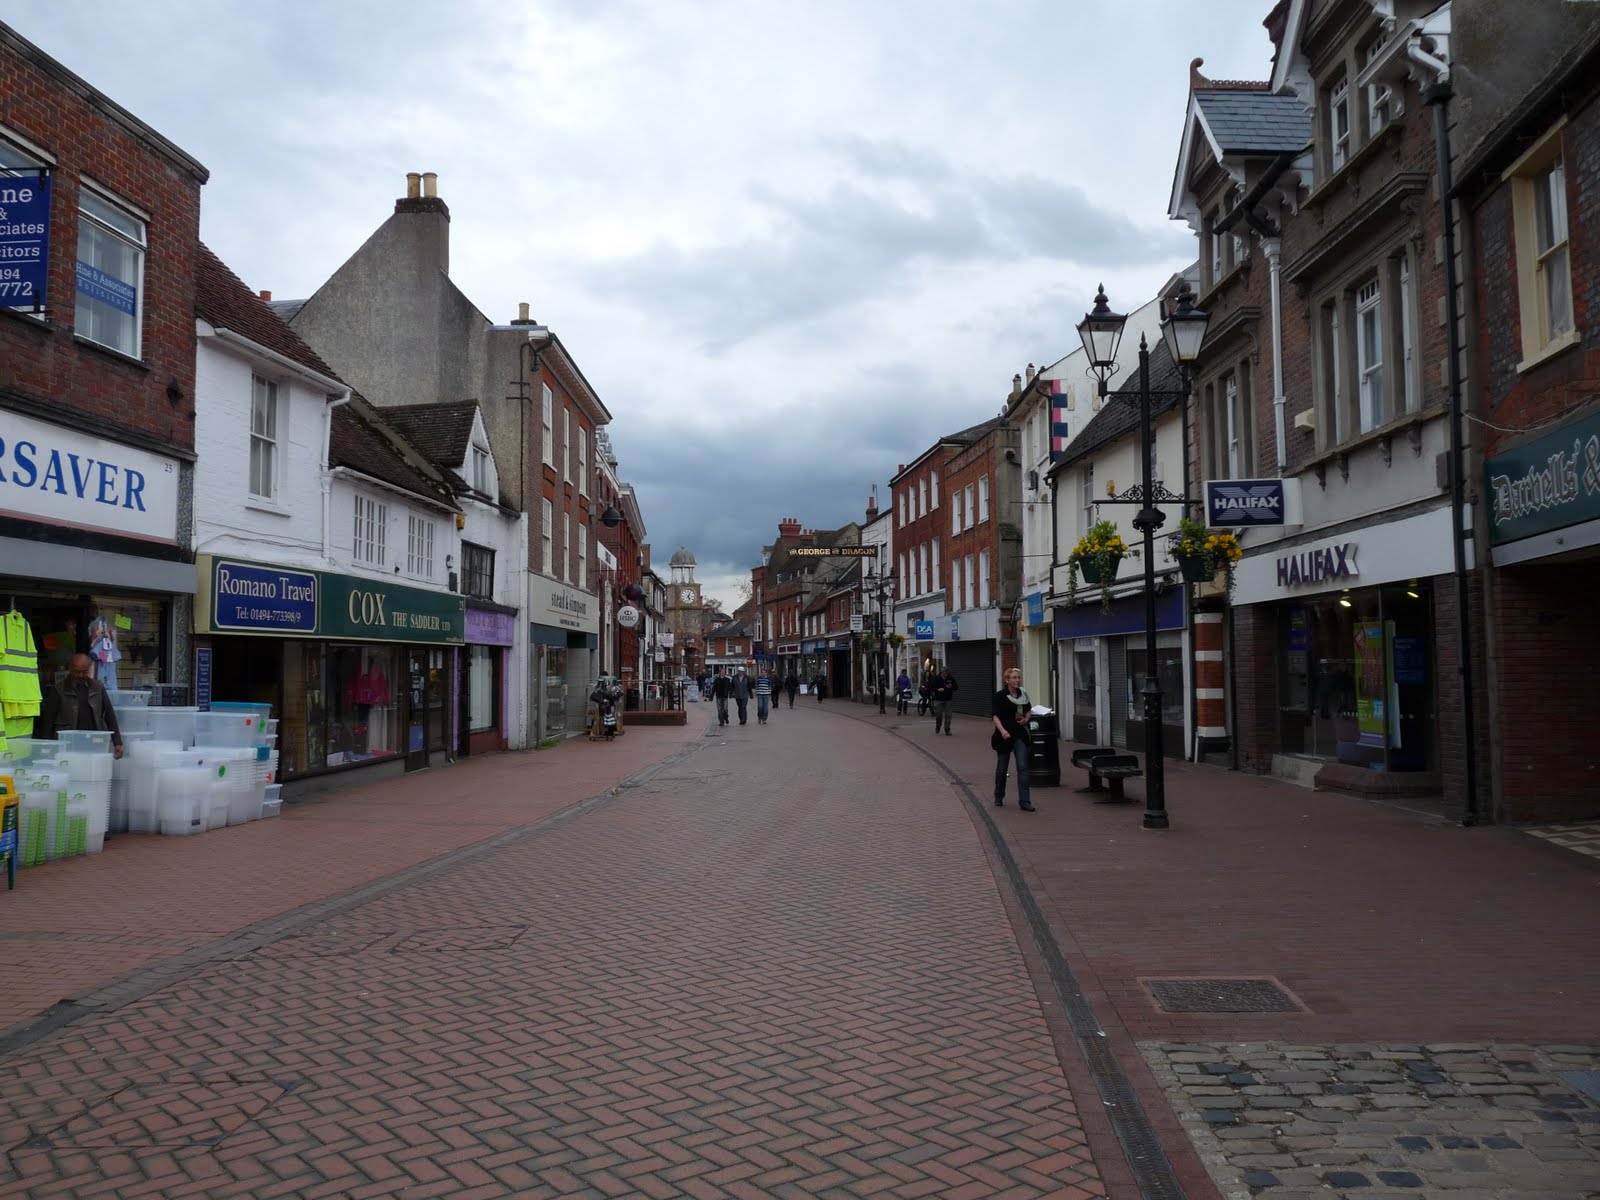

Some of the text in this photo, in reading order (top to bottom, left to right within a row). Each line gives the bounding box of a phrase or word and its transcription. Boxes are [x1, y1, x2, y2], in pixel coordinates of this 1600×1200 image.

[99, 274, 134, 299] Associates
[0, 436, 146, 512] SAVER
[1214, 495, 1280, 511] HALIFAX
[798, 548, 831, 556] GEORGE
[842, 548, 876, 556] DRAGON
[1276, 542, 1358, 587] HALIFAX
[219, 569, 315, 603] Romano Travel
[235, 606, 249, 620] Tel:
[348, 589, 387, 626] COX
[391, 611, 408, 628] THE
[410, 613, 440, 631] SADDLER
